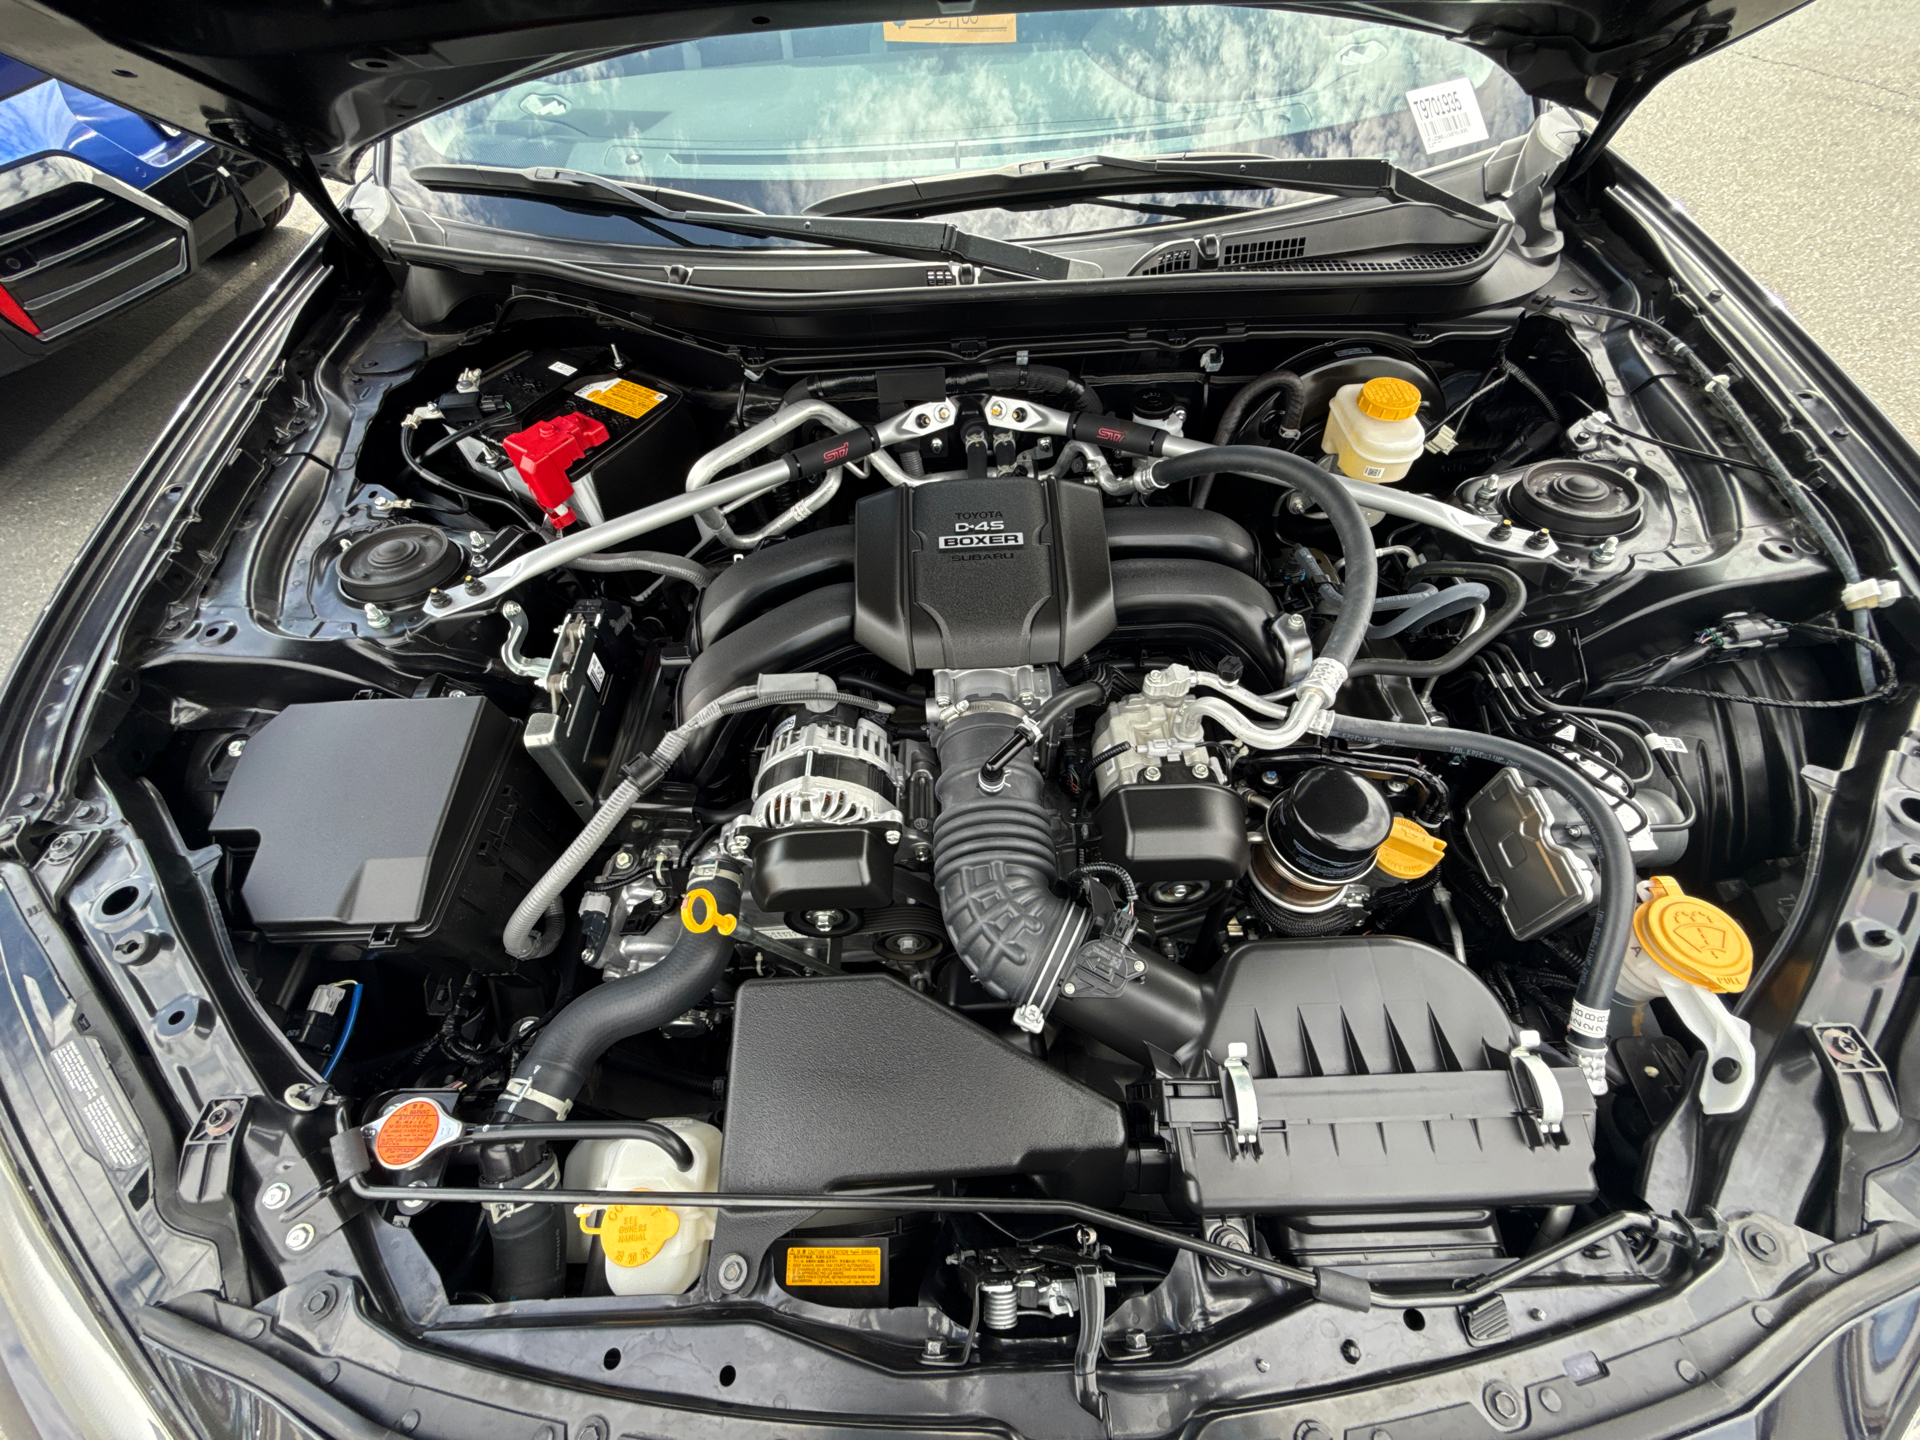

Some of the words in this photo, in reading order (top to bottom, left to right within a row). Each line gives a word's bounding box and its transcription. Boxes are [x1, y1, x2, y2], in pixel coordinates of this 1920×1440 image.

[1413, 91, 1462, 120] T9701935
[955, 511, 1003, 520] TOYOTA
[955, 520, 1005, 532] D-4S
[943, 534, 1019, 547] BOXER
[952, 552, 1014, 561] SUBARU
[1717, 977, 1743, 985] PULL
[624, 1216, 638, 1226] SEE
[618, 1233, 647, 1243] MANUAL
